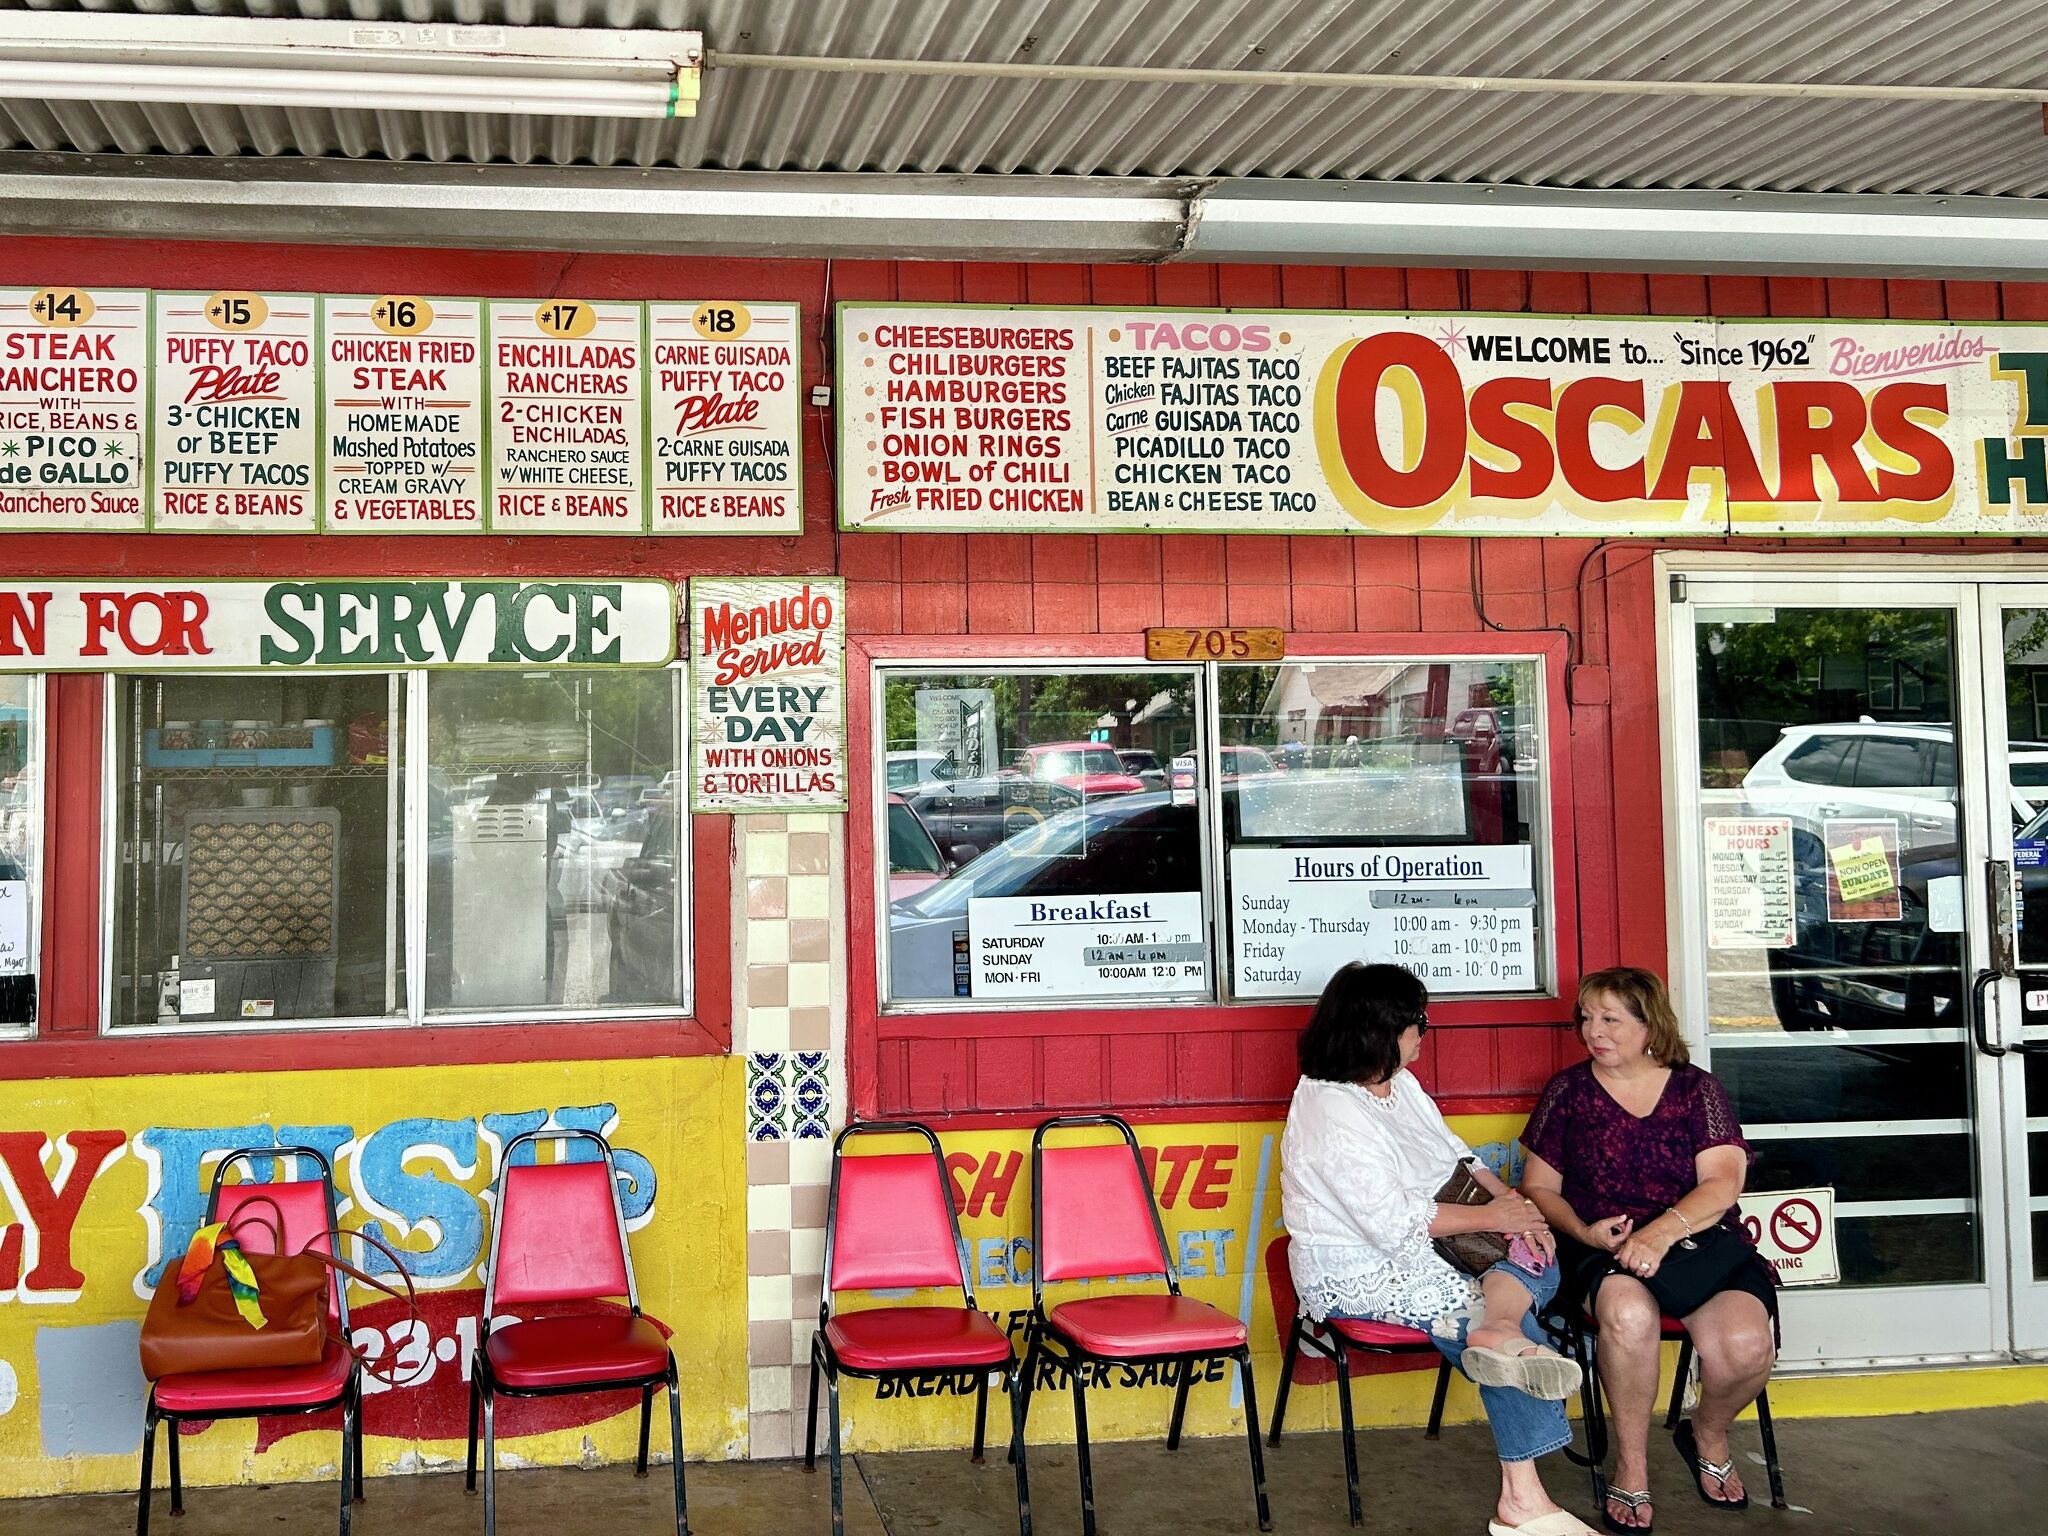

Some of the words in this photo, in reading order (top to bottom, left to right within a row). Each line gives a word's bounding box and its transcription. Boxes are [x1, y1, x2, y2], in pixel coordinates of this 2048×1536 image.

[34, 294, 81, 322] #14
[211, 299, 251, 325] #15
[376, 301, 416, 327] #16
[541, 306, 579, 330] #17
[698, 309, 736, 333] #18
[6, 333, 116, 360] STEAK
[875, 325, 1074, 350] CHEESEBURGERS
[1125, 322, 1272, 352] TACOS
[167, 338, 235, 365] PUFFY
[244, 339, 308, 367] TACO
[332, 340, 411, 363] CHICKEN
[418, 342, 475, 363] FRIED
[498, 344, 636, 370] ENCHILADAS
[655, 346, 710, 366] CARNE
[715, 346, 791, 366] GUISADA
[1467, 335, 1611, 364] WELCOME
[1829, 329, 2000, 376] Bienvenidos
[888, 355, 1066, 377] CHILIBURGERS
[1105, 356, 1155, 378] BEEF
[1162, 356, 1240, 380] FAJITAS
[1247, 358, 1300, 381] TACO
[184, 363, 280, 404] Plate
[353, 367, 447, 391] STEAK
[507, 372, 628, 394] RANCHERAS
[661, 370, 723, 392] PUFFY
[728, 371, 784, 392] TACO
[887, 380, 1067, 404] HAMBURGERS
[1105, 382, 1155, 405] Chicken
[1161, 383, 1239, 407] FAJITAS
[1246, 384, 1301, 407] TACO
[40, 398, 81, 410] WITH
[381, 397, 425, 410] WITH
[674, 392, 759, 436] Plate
[50, 413, 118, 430] BEANS
[348, 414, 460, 432] HOMEMADE
[881, 407, 946, 430] FISH
[955, 408, 1071, 432] BURGERS
[1106, 408, 1149, 432] Carne
[1155, 410, 1242, 432] GUISADA
[1246, 411, 1300, 434] TACO
[1335, 331, 1954, 508] OSCARS
[25, 436, 97, 458] PICO
[177, 435, 200, 454] or
[209, 432, 279, 455] BEEF
[333, 436, 398, 457] Mashed
[404, 436, 476, 457] Potatoes
[513, 426, 629, 447] ENCHILADAS,
[882, 434, 968, 457] ONION
[979, 435, 1061, 458] RINGS
[1116, 436, 1224, 459] PICADILLO
[1233, 437, 1290, 459] TACO
[507, 448, 587, 463] RANCHERO
[590, 450, 629, 463] SAUCE
[728, 440, 790, 457] GUISADA
[40, 462, 129, 484] GALLO
[164, 461, 233, 485] PUFFY
[240, 462, 309, 487] TACOS
[365, 461, 424, 475] TOPPED
[568, 468, 633, 488] CHEESE,
[666, 461, 726, 482] PUFFY
[730, 462, 787, 481] TACOS
[882, 462, 961, 484] BOWL
[969, 461, 996, 482] of
[1002, 462, 1069, 483] CHILI
[1114, 464, 1221, 484] CHICKEN
[1232, 464, 1290, 484] TACO
[339, 479, 397, 494] CREAM
[405, 479, 465, 494] GRAVY
[91, 491, 139, 514] Sauce
[164, 492, 208, 515] RICE
[235, 493, 303, 516] BEANS
[355, 499, 476, 520] VEGETABLES
[498, 495, 544, 516] RICE
[566, 495, 628, 517] BEANS
[662, 495, 706, 518] RICE
[724, 495, 785, 517] BEANS
[870, 488, 912, 511] Fresh
[916, 488, 981, 512] FRIED
[988, 488, 1084, 512] CHICKEN
[1108, 490, 1159, 512] BEAN
[1178, 491, 1263, 512] CHEESE
[1270, 492, 1317, 513] TACO
[80, 591, 213, 656] FOR
[260, 582, 621, 665] SERVICE
[704, 585, 832, 655] Menudo
[1185, 630, 1250, 658] 705
[715, 632, 826, 685] Served
[707, 687, 826, 712] EVERY
[725, 716, 813, 742] DAY
[706, 749, 755, 767] WITH
[762, 748, 831, 767] ONIONS
[724, 772, 835, 793] TORTILLAS
[1719, 825, 1778, 836] BUSINESS
[1727, 839, 1770, 849] HOURS
[1712, 853, 1744, 861] MONDAY
[1713, 864, 1744, 872] TUESDAY
[1840, 864, 1860, 877] NOW
[1862, 858, 1886, 870] OPEN
[1295, 857, 1354, 878] Hours
[1361, 855, 1380, 877] of
[1385, 855, 1483, 882] Operation
[1713, 875, 1757, 883] WEDNESDAY
[1841, 868, 1889, 888] SUNDAYS
[1714, 886, 1751, 895] THURSDAY
[1030, 900, 1152, 921] Breakfast
[1242, 895, 1290, 912] Sunday
[1394, 893, 1408, 904] 12
[1714, 898, 1738, 906] FRIDAY
[1714, 909, 1751, 917] SATURDAY
[1242, 918, 1296, 934] Monday
[1309, 918, 1370, 934] Thursday
[1393, 916, 1427, 931] 10:00
[1431, 920, 1451, 931] am
[1470, 915, 1497, 930] 9:30
[1500, 918, 1521, 933] pm
[1715, 920, 1744, 928] SUNDAY
[982, 937, 1045, 948] SATURDAY
[1175, 933, 1190, 943] pm
[1243, 943, 1284, 960] Friday
[1432, 943, 1452, 954] am
[1501, 941, 1521, 956] pm
[982, 954, 1032, 965] SUNDAY
[1091, 950, 1104, 960] 12
[1098, 967, 1146, 978] 10:00AM
[1185, 966, 1202, 976] PM
[1244, 966, 1301, 984] Saturday
[1432, 966, 1452, 977] am
[1502, 964, 1522, 979] pm
[1772, 1257, 1803, 1269] KING
